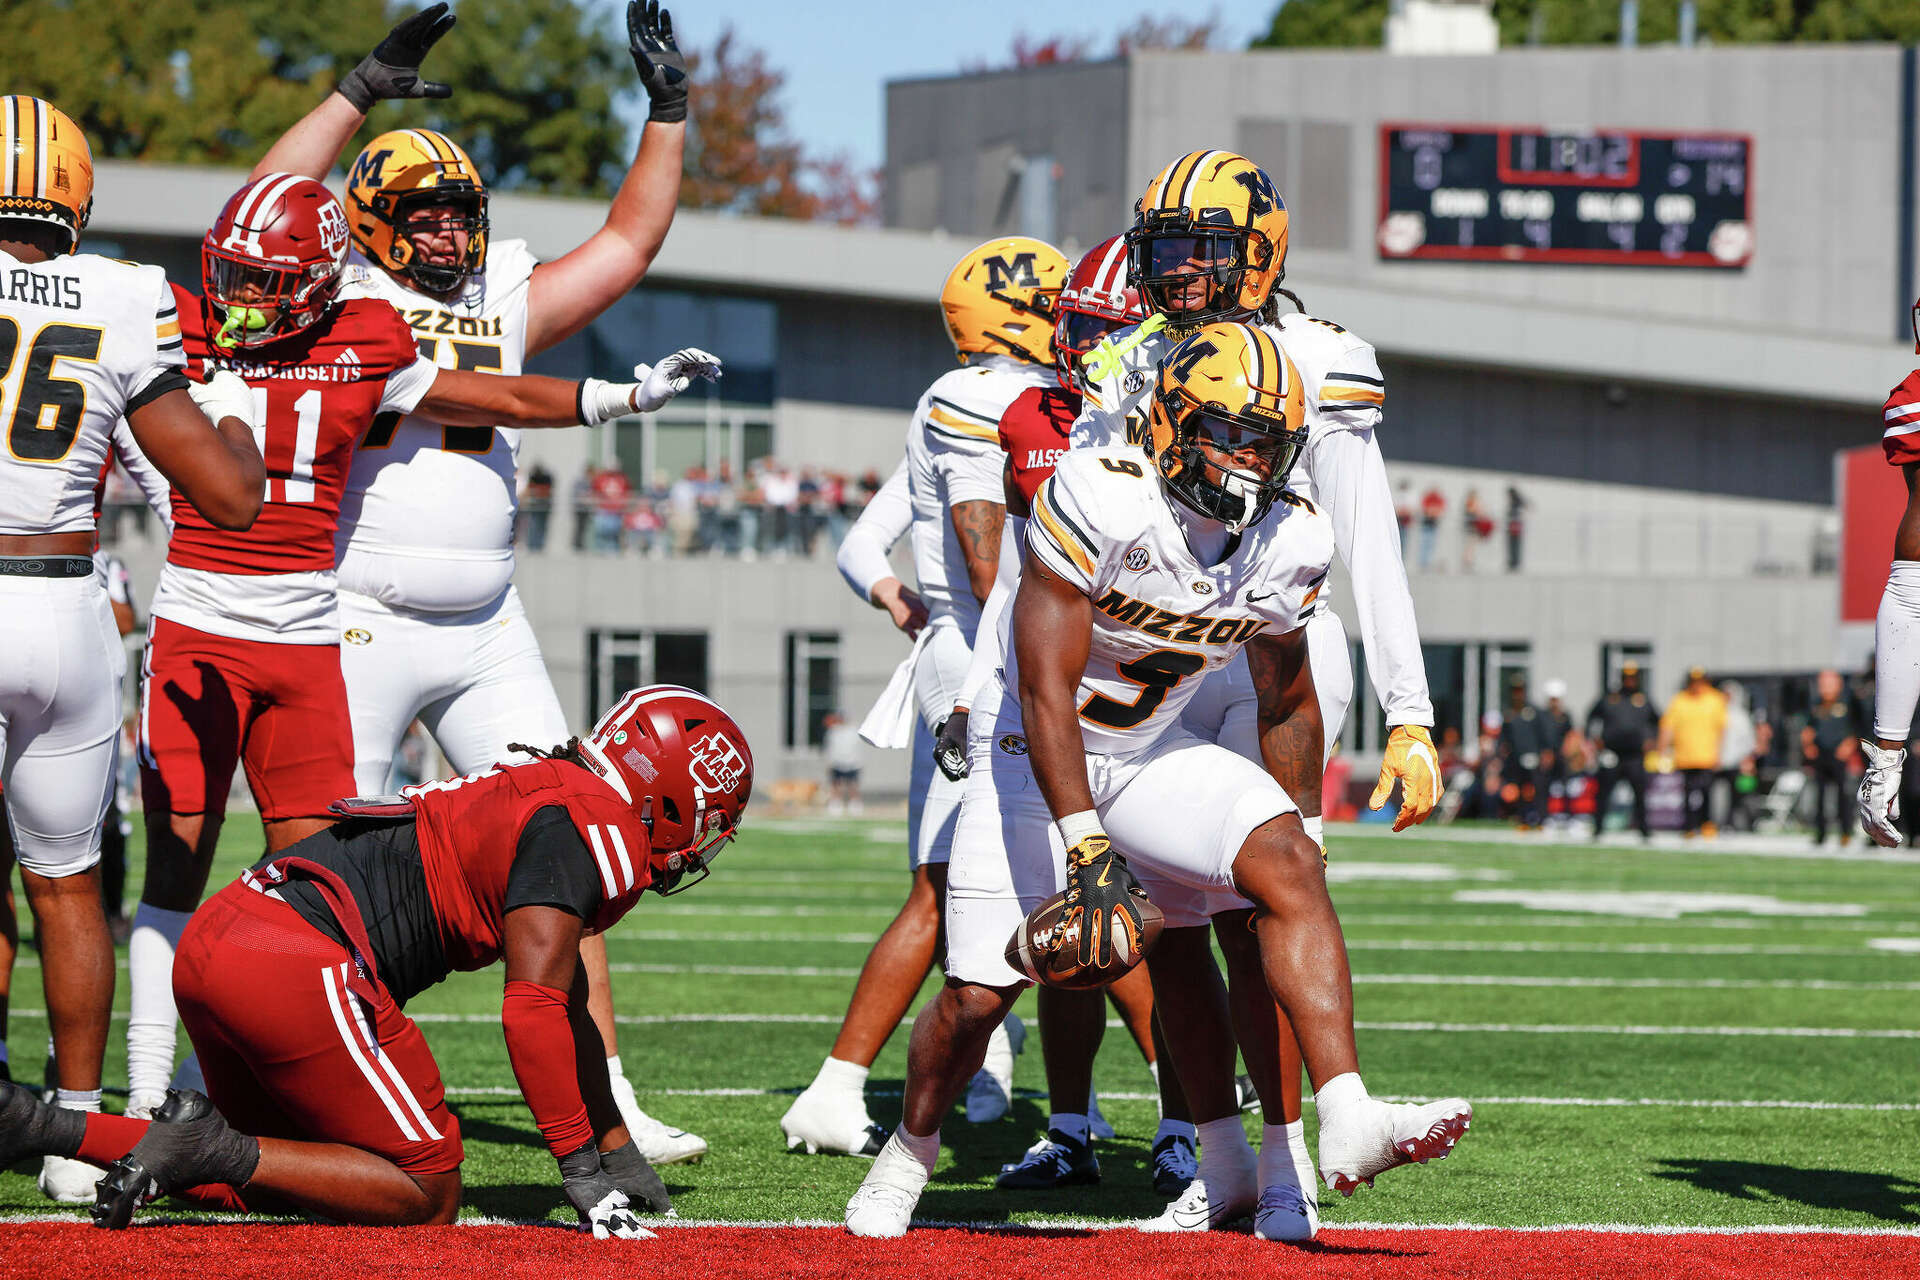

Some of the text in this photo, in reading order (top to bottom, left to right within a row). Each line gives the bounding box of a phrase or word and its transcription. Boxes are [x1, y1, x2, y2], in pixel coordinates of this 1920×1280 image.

[352, 150, 394, 189] M
[1232, 168, 1286, 218] M
[0, 269, 81, 310] RRIS
[984, 253, 1041, 292] M
[395, 306, 502, 337] ZZOU
[1163, 333, 1219, 385] M
[0, 315, 106, 463] 6
[1250, 405, 1284, 421] MIZZOU
[1095, 587, 1272, 646] MIZZOU
[607, 723, 617, 737] 8
[689, 735, 739, 794] MASS
